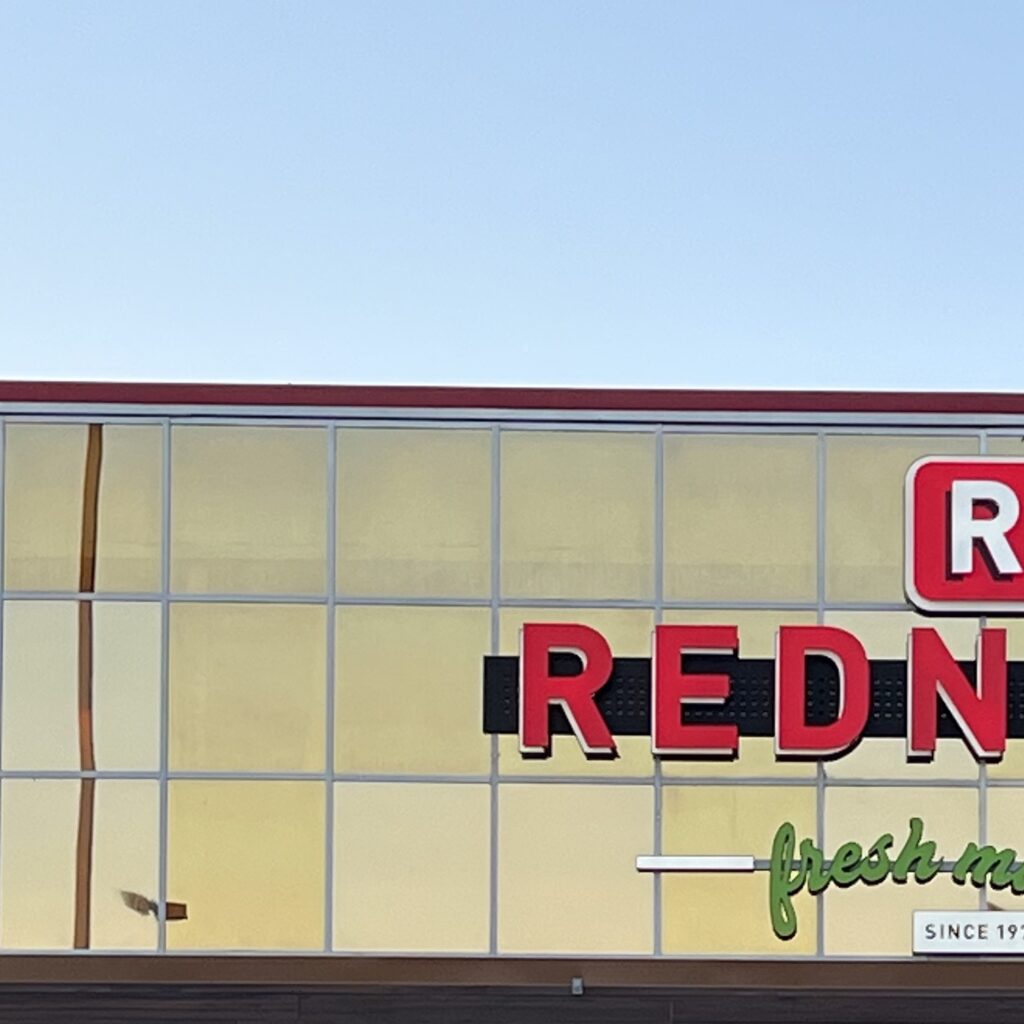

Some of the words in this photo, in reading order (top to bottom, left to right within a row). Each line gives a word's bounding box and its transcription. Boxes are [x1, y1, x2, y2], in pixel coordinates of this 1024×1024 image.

[949, 480, 1022, 575] R
[770, 817, 943, 939] fresh
[925, 924, 988, 940] SINCE
